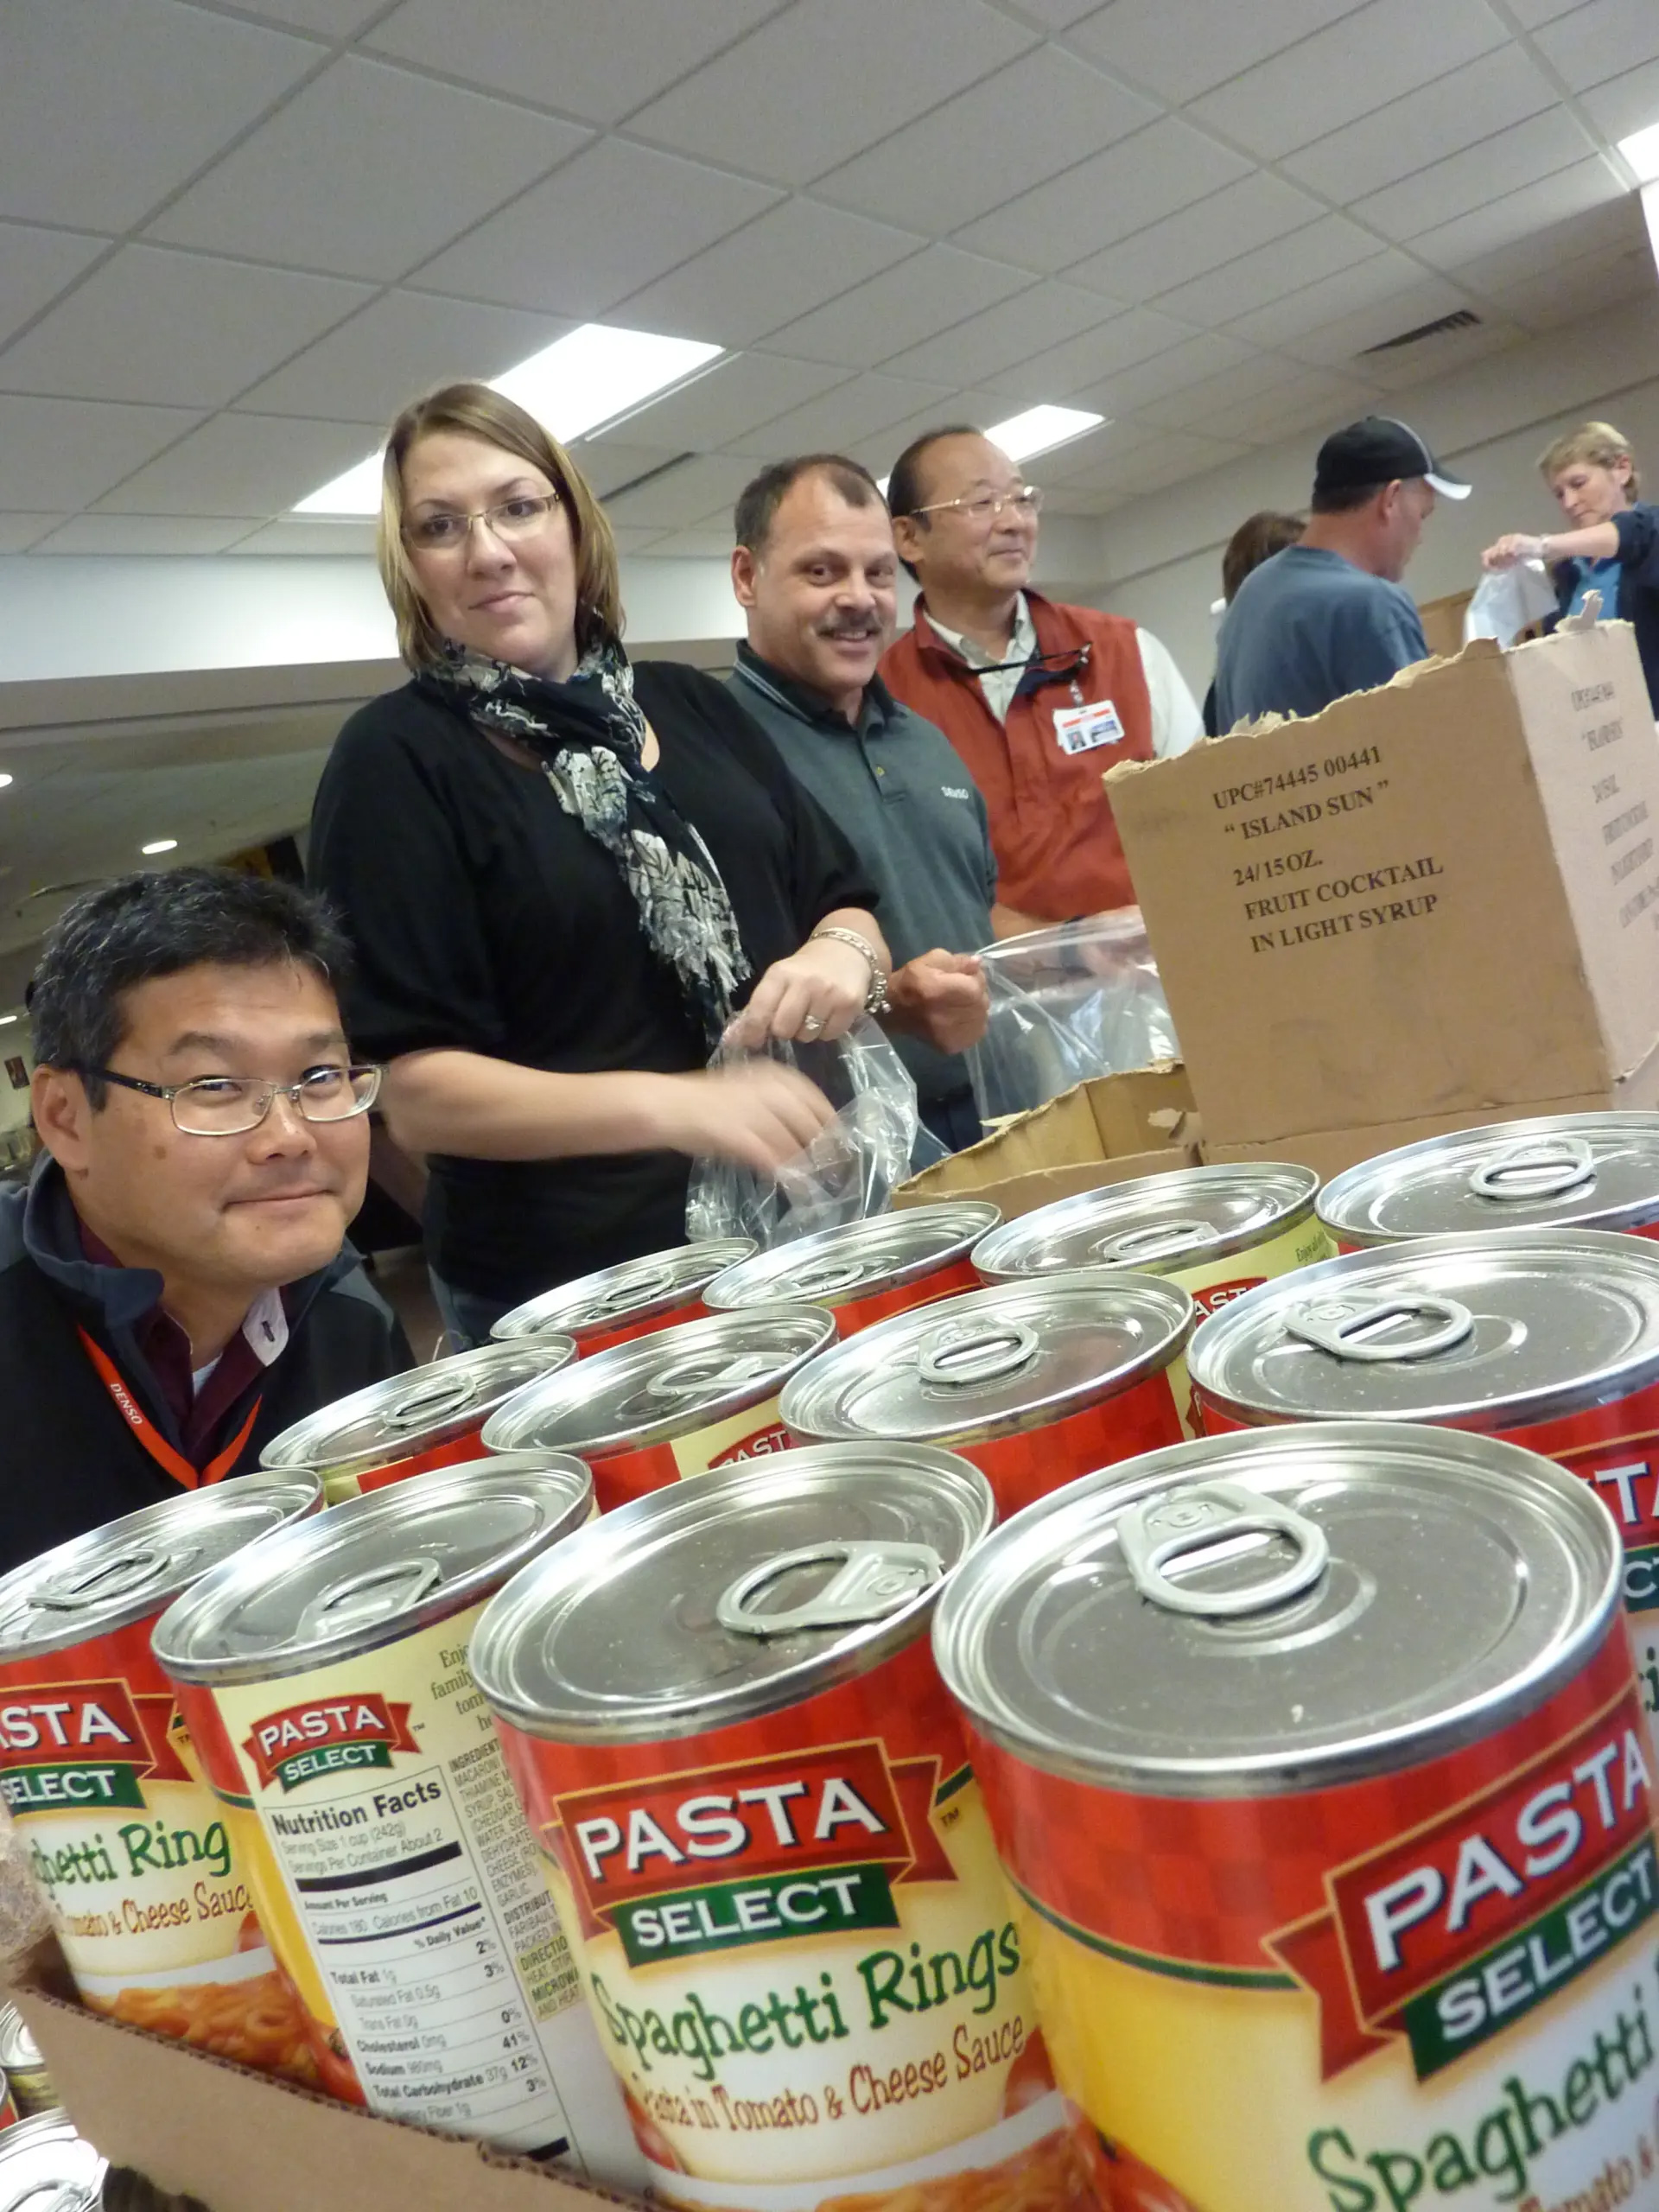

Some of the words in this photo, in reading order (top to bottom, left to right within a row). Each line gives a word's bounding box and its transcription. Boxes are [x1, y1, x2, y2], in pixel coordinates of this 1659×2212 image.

[1213, 764, 1319, 810] UPC#74445
[1324, 746, 1381, 778] 00441
[1244, 889, 1311, 920] FRUIT
[1316, 857, 1444, 902] COCKTAIL
[1250, 932, 1275, 953] IN
[1281, 914, 1354, 947] LIGHT
[1359, 893, 1438, 929] SYRUP
[110, 1382, 143, 1425] DENSO
[430, 1669, 474, 1700] family
[260, 1705, 385, 1757] PASTA
[283, 1745, 377, 1782] SELECT
[272, 1806, 369, 1836] Nutrition
[372, 1781, 442, 1818] Facts
[433, 1827, 443, 1841] 2
[575, 1777, 888, 1879] PASTA
[939, 1807, 960, 1827] TM
[1364, 1729, 1651, 1972] PASTA
[123, 1898, 192, 1934] Cheese
[631, 1873, 862, 1948] SELECT
[1437, 1848, 1652, 2041] SELECT
[359, 1970, 380, 1985] Fat
[591, 1971, 850, 2082] Spaghetti
[856, 1922, 1020, 2031] Rings
[711, 2083, 820, 2132] Tomato
[824, 2085, 844, 2120] &
[849, 2050, 948, 2114] Cheese
[953, 2015, 1025, 2081] Sauce
[1307, 1981, 1655, 2212] Spaghetti
